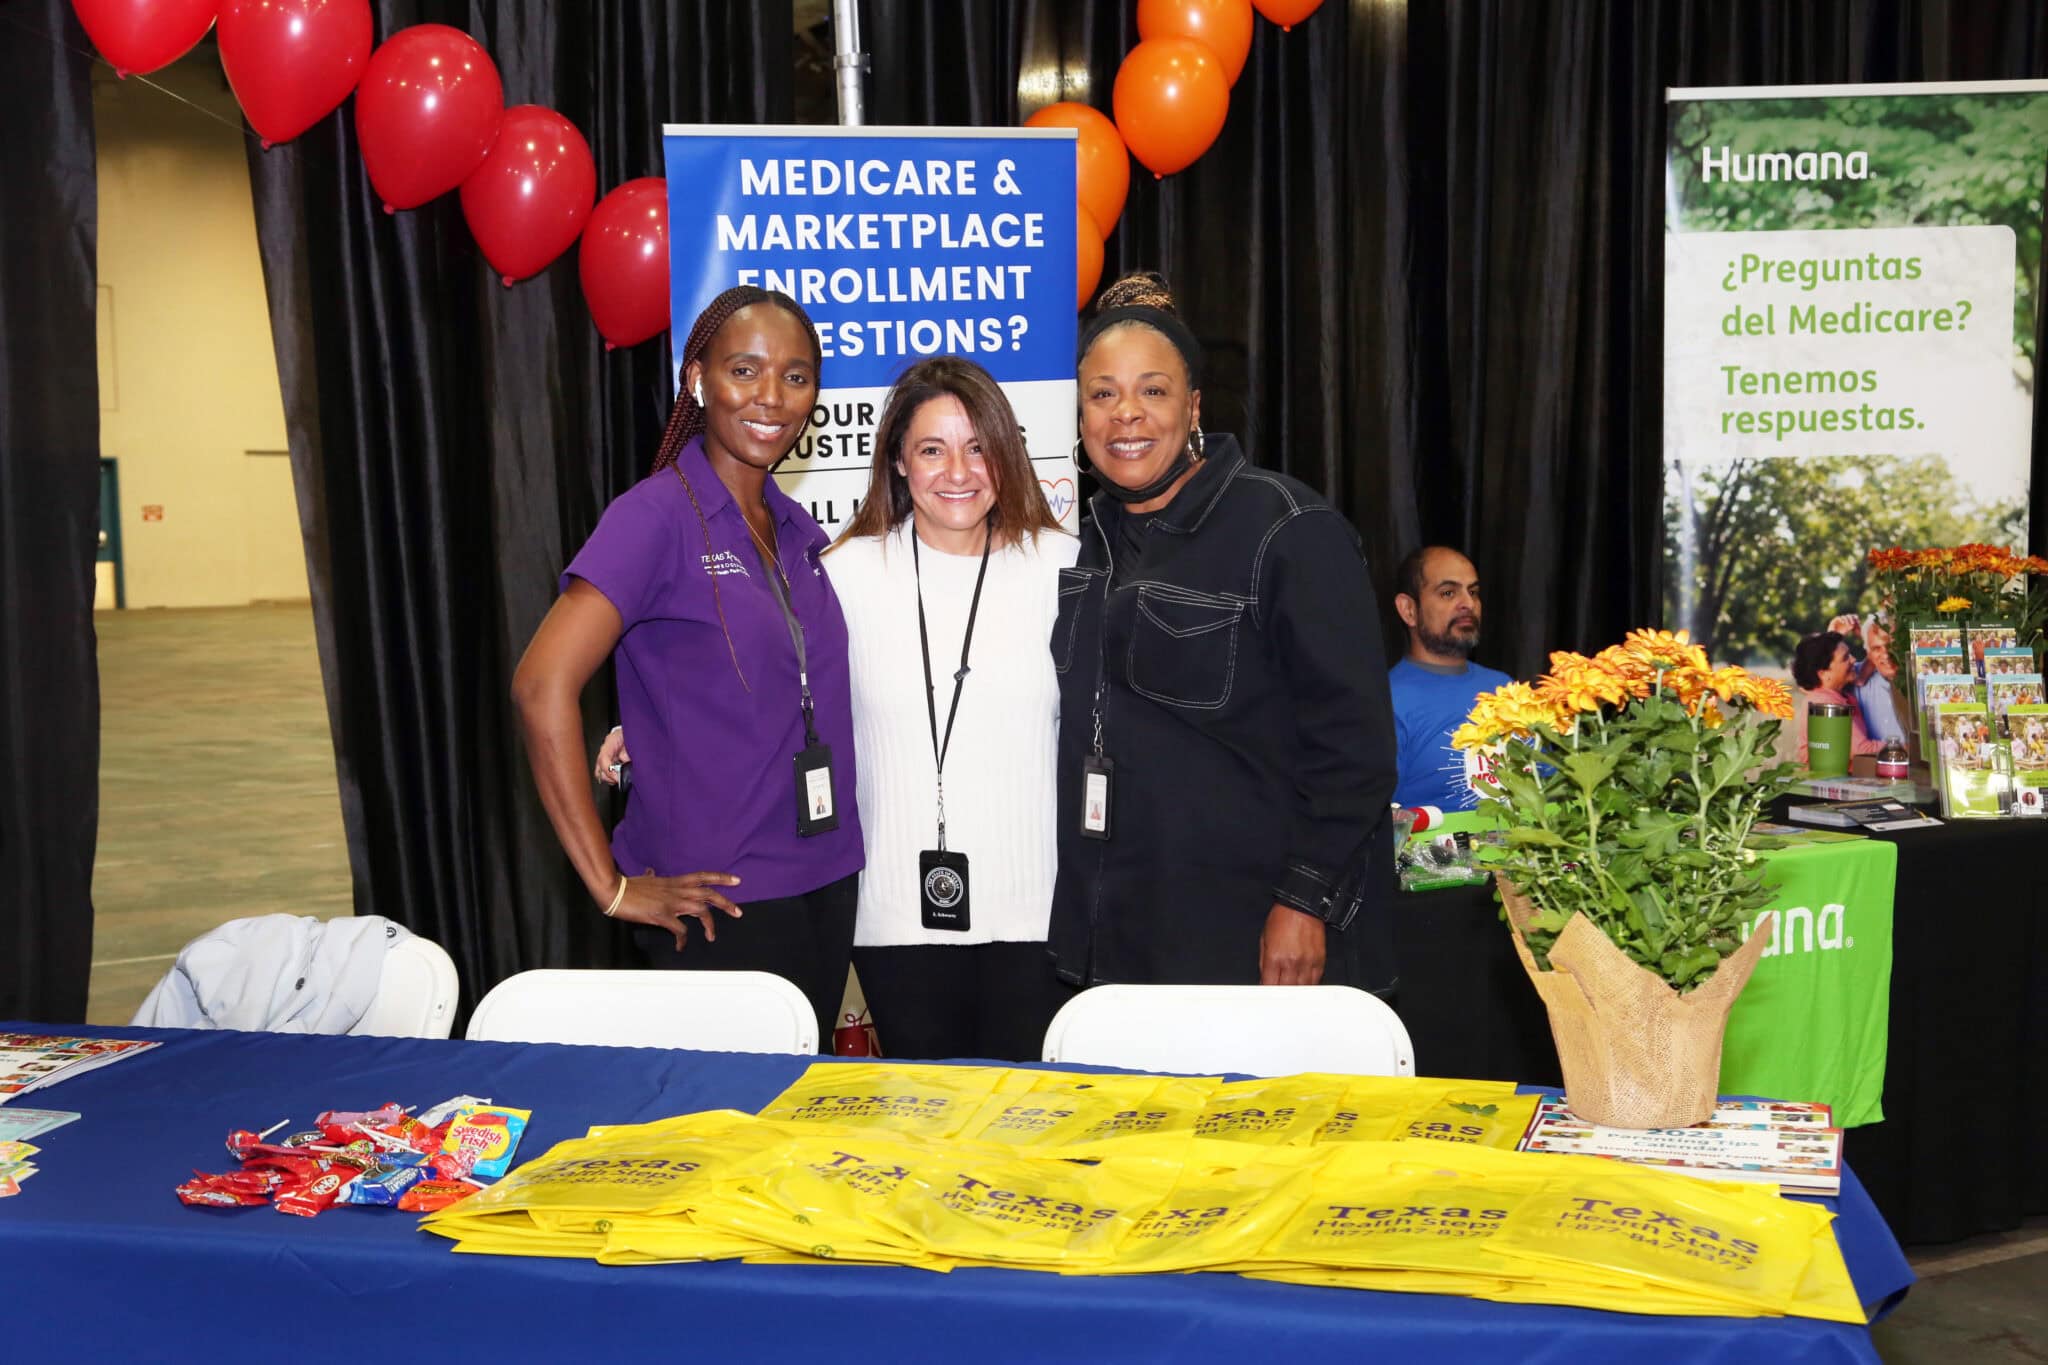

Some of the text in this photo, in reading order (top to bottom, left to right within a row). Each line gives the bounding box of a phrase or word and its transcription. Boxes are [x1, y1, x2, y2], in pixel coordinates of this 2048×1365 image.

[740, 159, 1022, 196] MEDICARE &
[716, 213, 1045, 251] MARKETPLACE
[1722, 253, 1922, 291] ¿Preguntas
[1722, 300, 1972, 336] del Medicare?
[813, 315, 1028, 359] ESTIONS?
[1721, 366, 1877, 395] Tenemos
[1721, 403, 1925, 441] respuestas.
[808, 1095, 949, 1107] Texas
[1209, 1107, 1296, 1121] xas
[453, 1125, 503, 1145] Swedish
[461, 1135, 489, 1150] Fish
[1607, 1133, 1710, 1145] Parenting
[1648, 1128, 1723, 1139] 2023
[1634, 1142, 1725, 1152] Calendar
[556, 1159, 701, 1172] Texas
[957, 1174, 1118, 1219] Texas
[1035, 1209, 1094, 1228] Step
[1328, 1206, 1509, 1220] Texas
[1312, 1227, 1495, 1238] 1-877-847-8377
[1317, 1217, 1502, 1230] Health Steps
[1571, 1197, 1760, 1255] Texas
[1561, 1212, 1753, 1264] Health Steps
